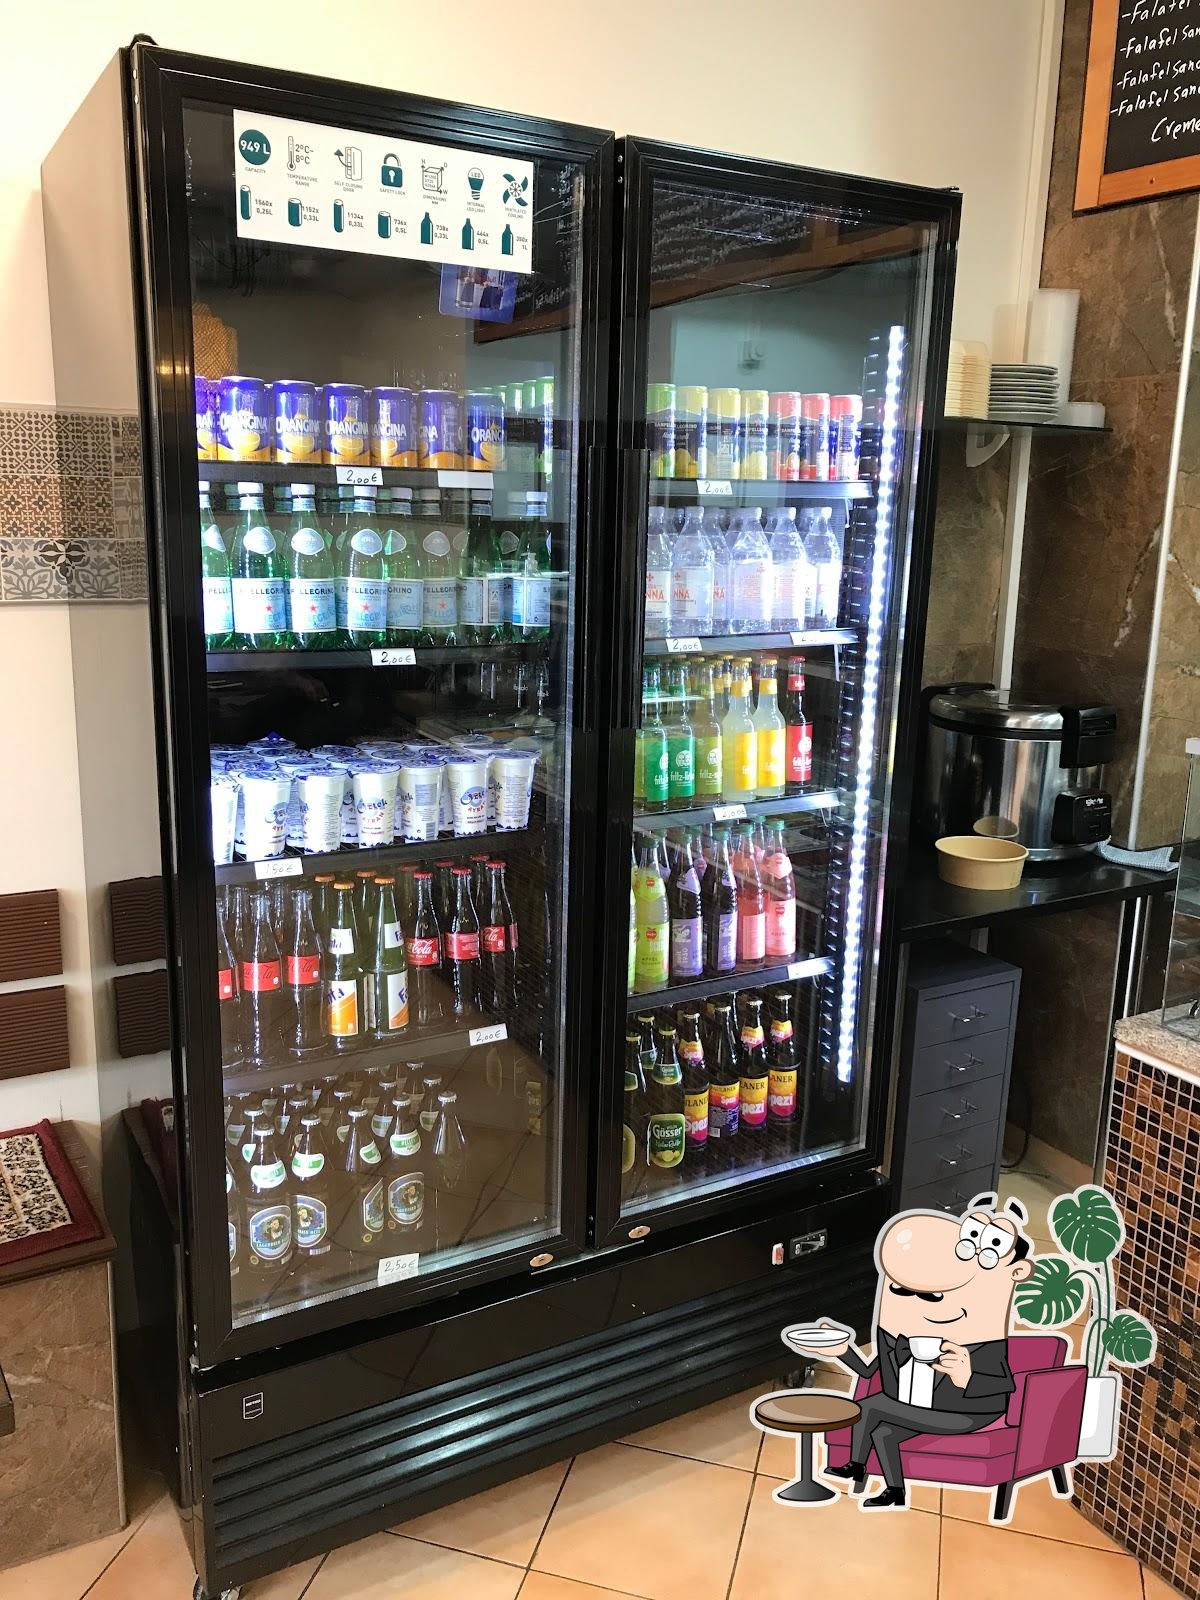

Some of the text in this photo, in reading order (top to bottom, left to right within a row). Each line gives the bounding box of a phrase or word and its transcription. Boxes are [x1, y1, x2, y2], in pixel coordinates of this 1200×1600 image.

[1120, 28, 1178, 58] -Falafel
[1117, 61, 1170, 90] -Falafel
[1110, 88, 1169, 116] -Falafel
[240, 139, 270, 155] 949 L
[295, 154, 310, 165] 8°C
[255, 199, 273, 208] 1560x
[346, 469, 377, 484] 2,00€
[672, 638, 699, 652] 2,00€
[381, 650, 412, 665] 2,00€
[475, 1029, 501, 1043] 2,00€
[652, 1123, 683, 1141] Gösser
[384, 1258, 416, 1273] 2,50€
